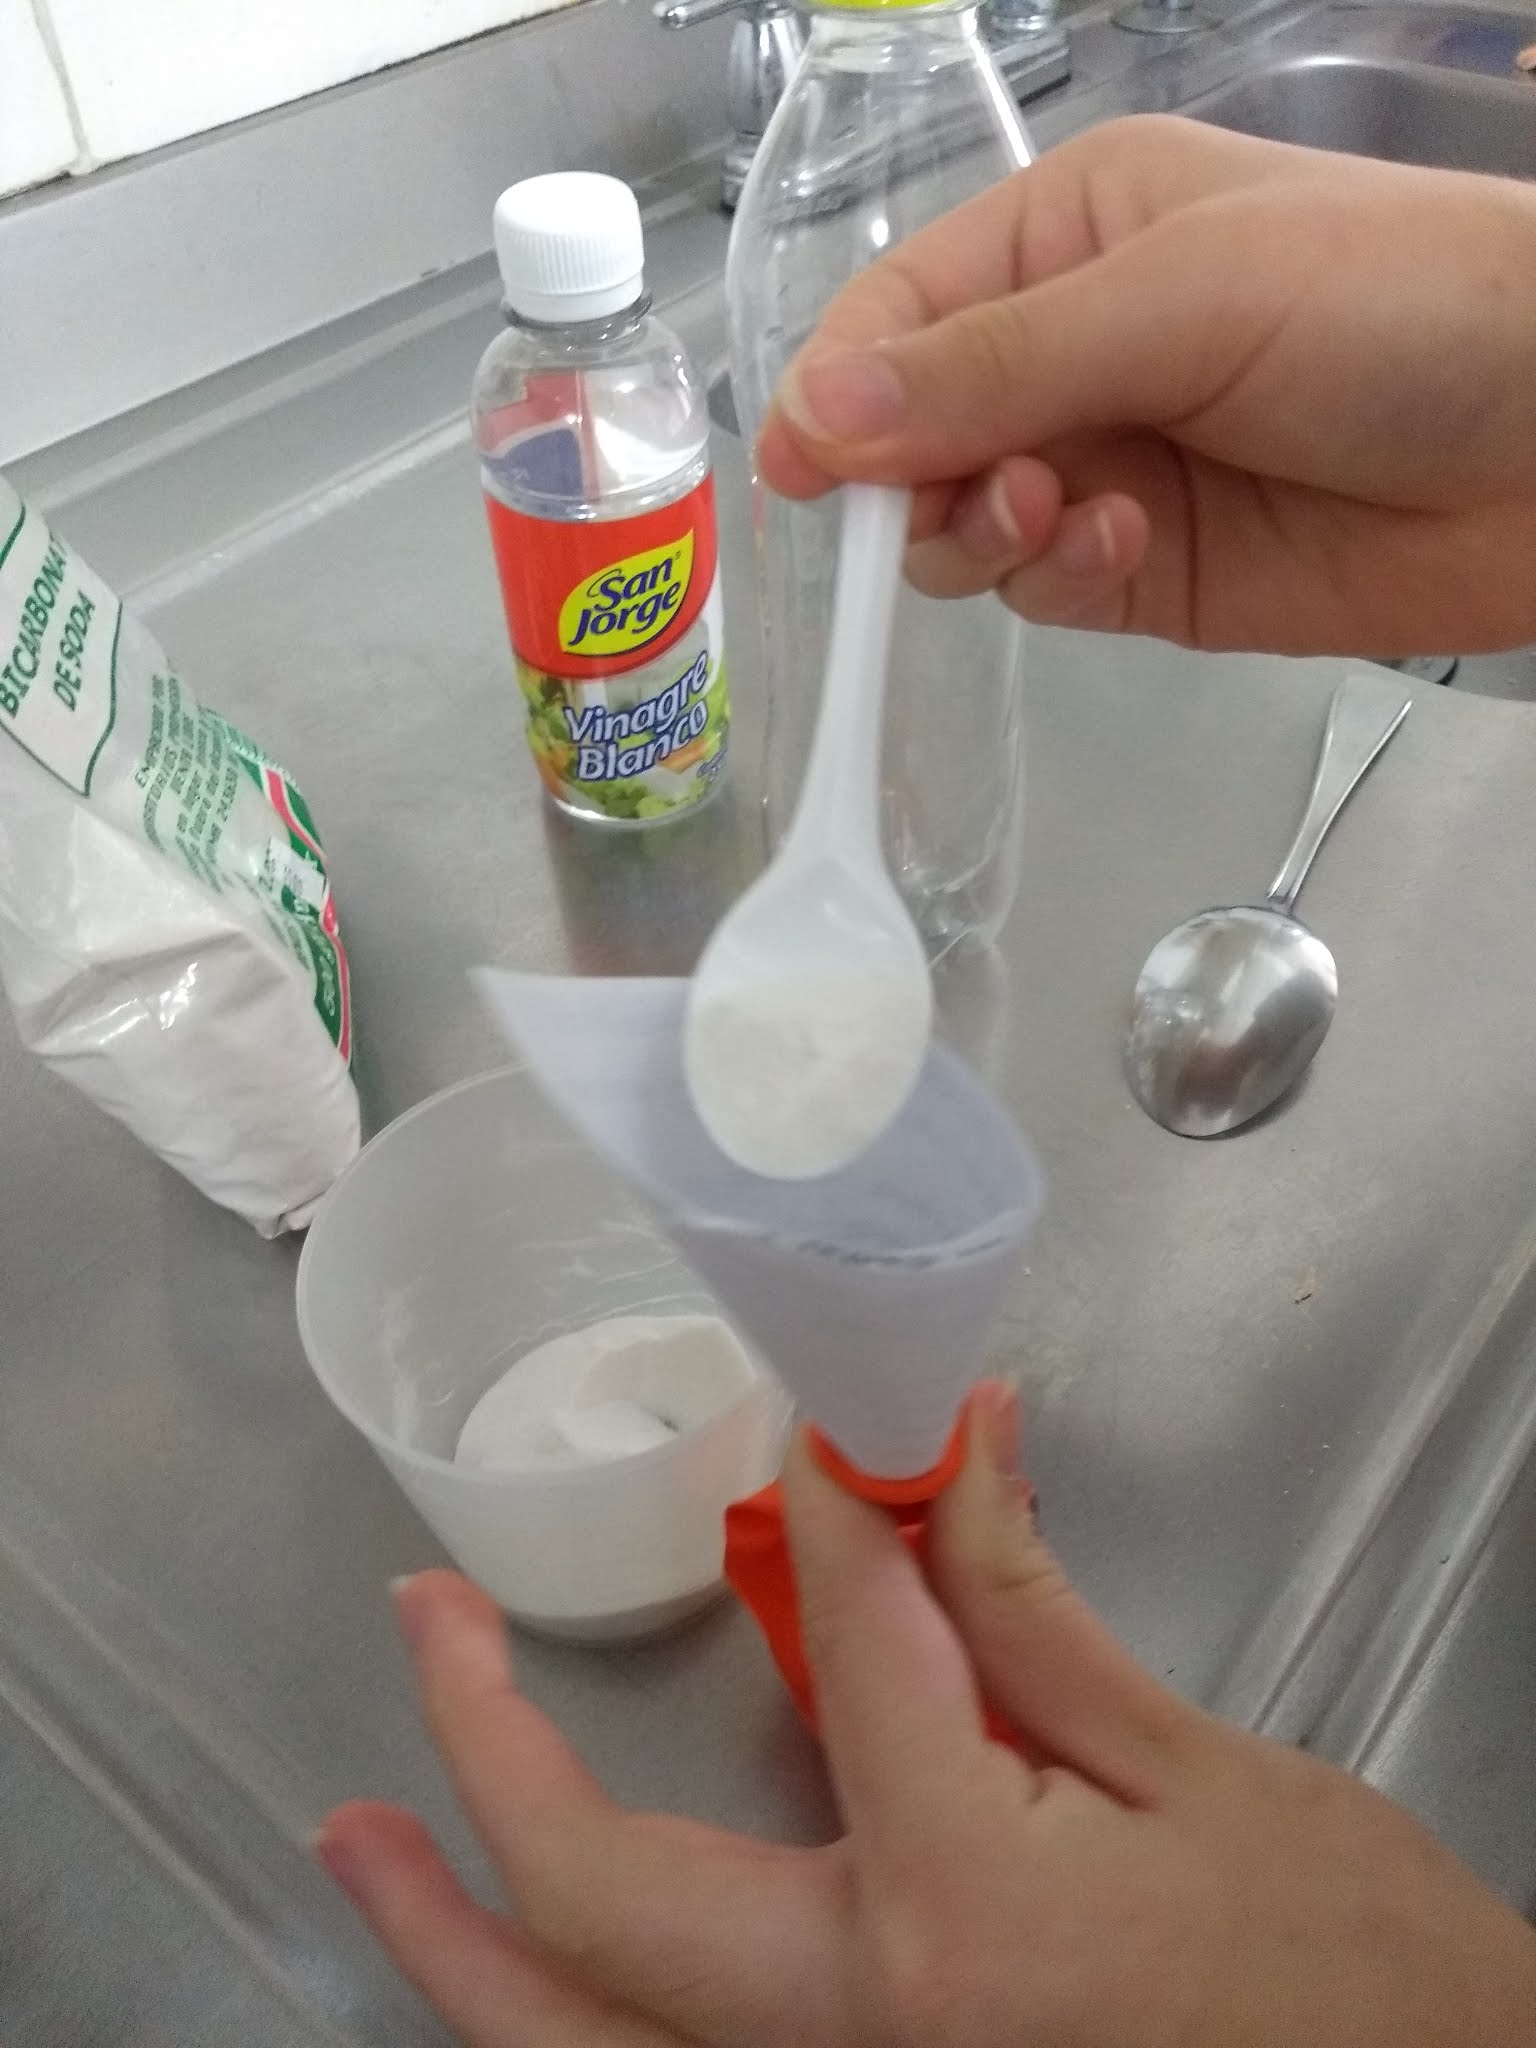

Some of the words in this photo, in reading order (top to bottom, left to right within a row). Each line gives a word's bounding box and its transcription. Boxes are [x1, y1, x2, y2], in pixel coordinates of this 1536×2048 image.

[567, 581, 680, 646] Jorge
[587, 558, 673, 611] San
[60, 590, 96, 669] SODA
[53, 660, 82, 711] DE
[563, 650, 708, 744] Vinagre
[576, 700, 708, 782] Blanco
